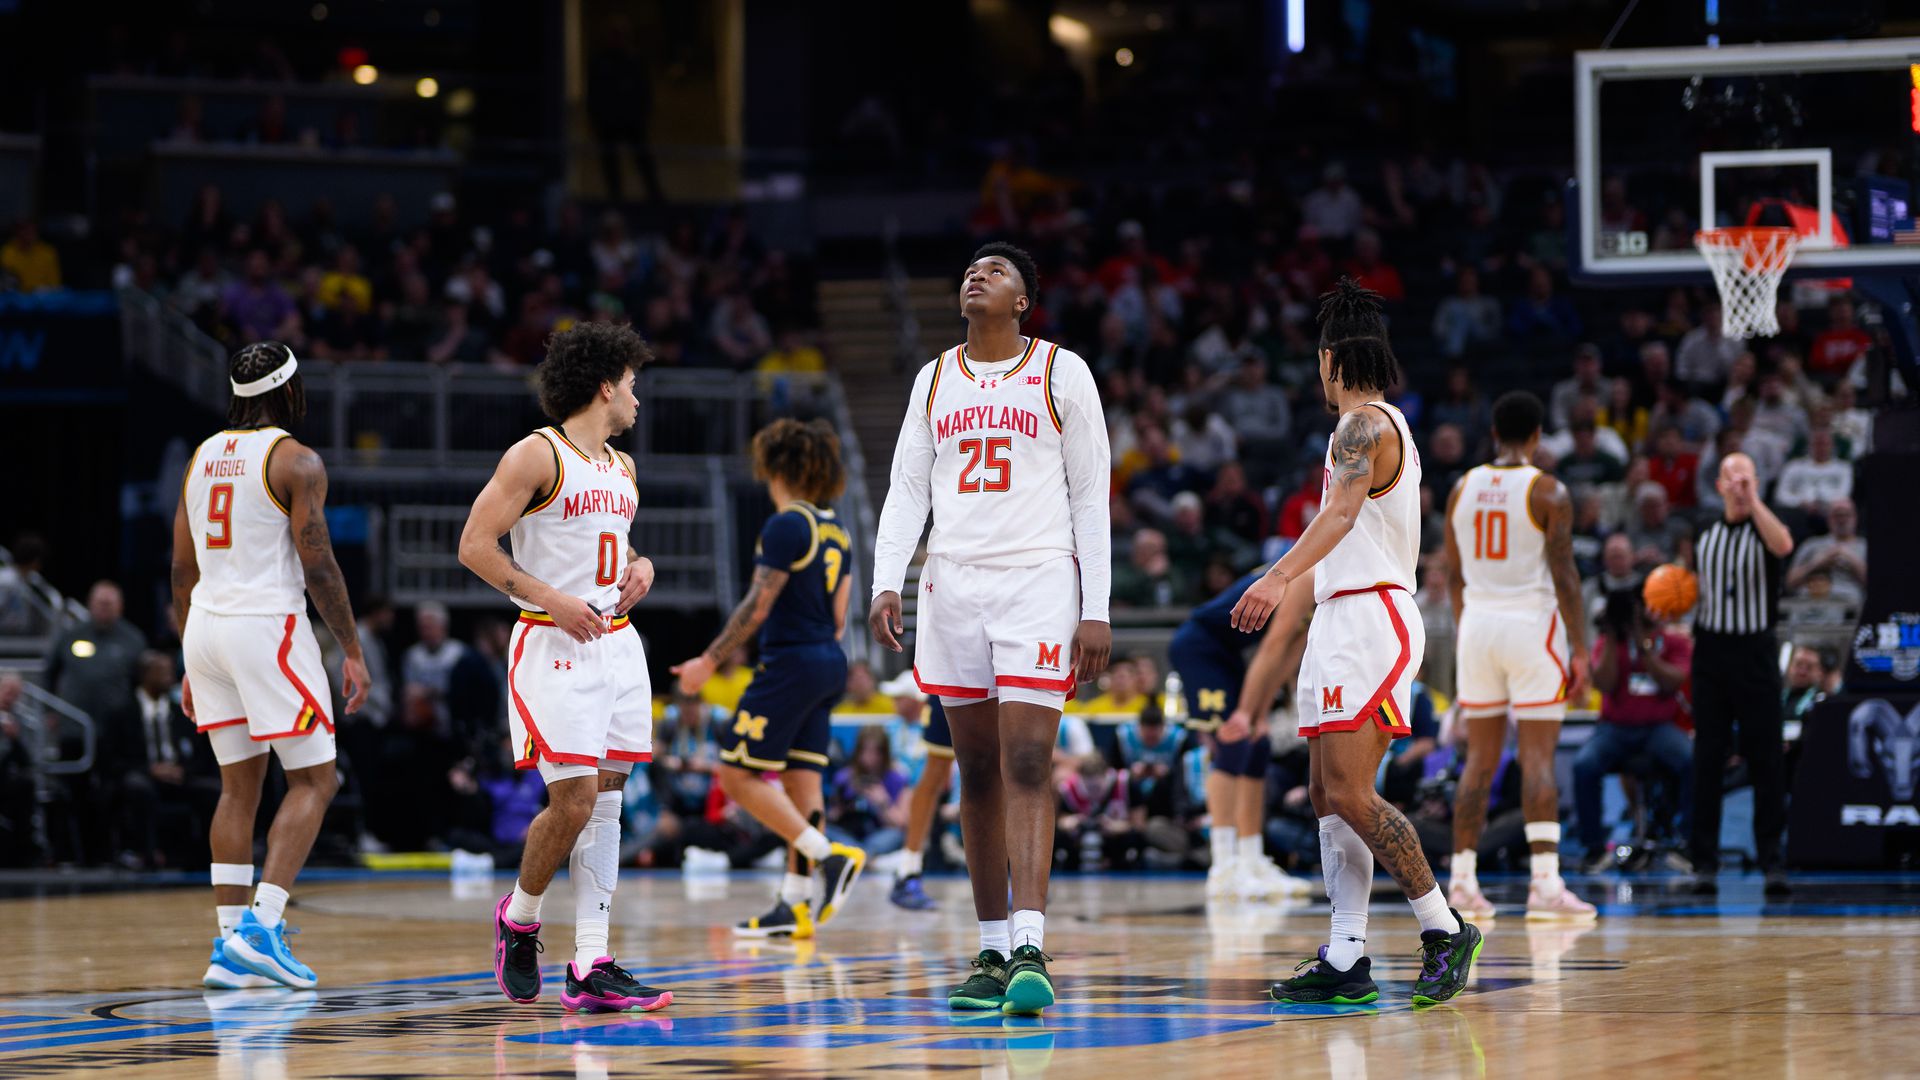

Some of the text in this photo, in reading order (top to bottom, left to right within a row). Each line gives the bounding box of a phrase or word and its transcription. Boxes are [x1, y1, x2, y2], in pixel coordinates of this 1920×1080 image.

[937, 405, 1038, 444] MARYLAND
[224, 439, 239, 454] M
[204, 459, 246, 478] MIGUEL
[958, 437, 1012, 494] 25
[206, 482, 234, 549] 9
[562, 489, 637, 520] MARYLAN
[1474, 510, 1508, 561] 10
[595, 531, 618, 587] 0
[824, 547, 842, 593] 3
[1036, 641, 1063, 668] M
[1322, 685, 1345, 711] M
[734, 710, 768, 740] M
